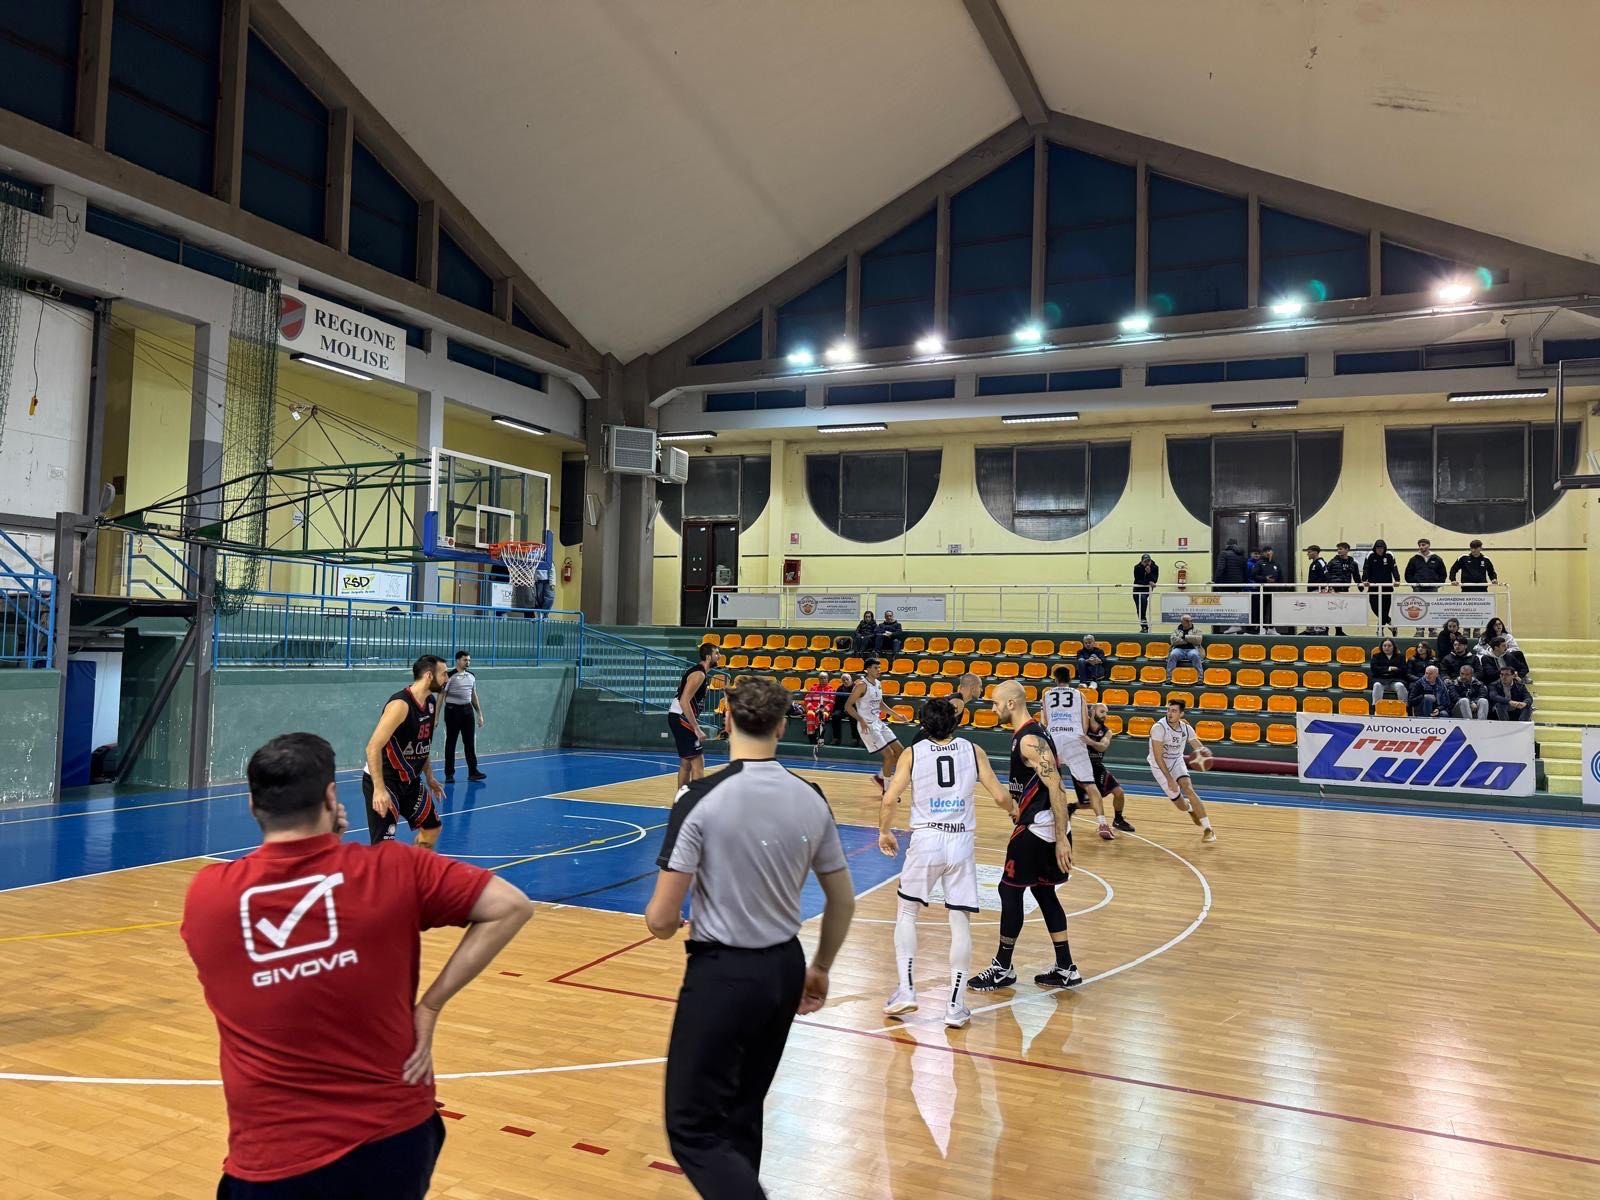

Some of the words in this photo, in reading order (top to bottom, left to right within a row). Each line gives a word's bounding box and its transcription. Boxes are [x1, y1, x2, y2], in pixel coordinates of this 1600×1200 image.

[315, 308, 396, 351] REGIONE
[320, 335, 389, 371] MOLISE
[343, 576, 370, 588] RSD
[1049, 691, 1073, 708] 33
[417, 722, 430, 740] 85
[1366, 725, 1447, 735] AUTONOLEGGIO
[1304, 719, 1527, 791] Zullo
[1353, 735, 1441, 756] rent
[936, 755, 955, 788] 0
[252, 949, 358, 987] GIVOVA
